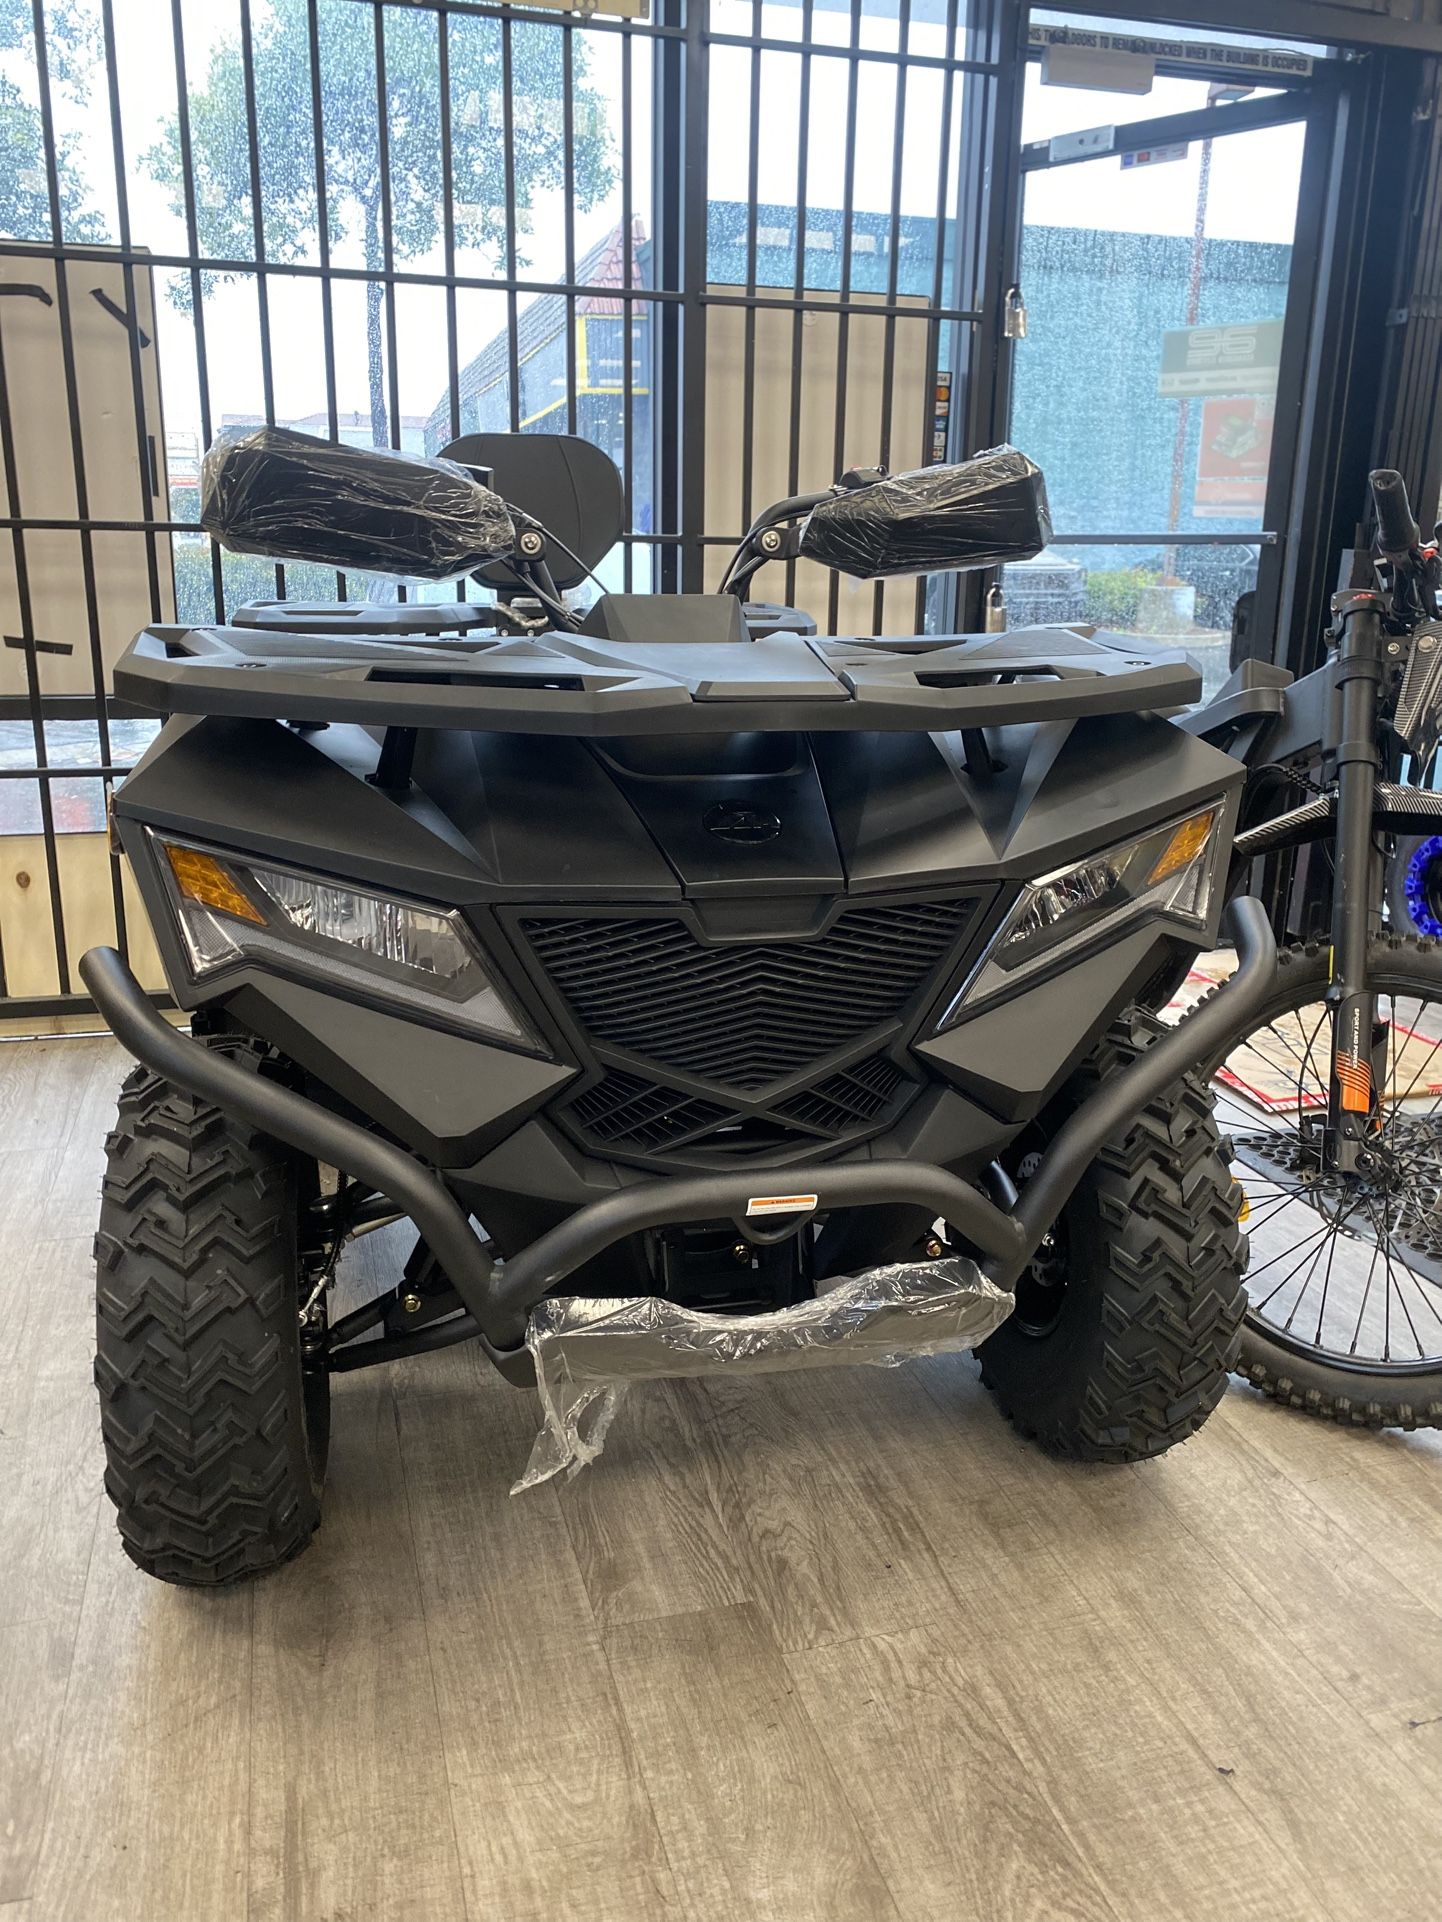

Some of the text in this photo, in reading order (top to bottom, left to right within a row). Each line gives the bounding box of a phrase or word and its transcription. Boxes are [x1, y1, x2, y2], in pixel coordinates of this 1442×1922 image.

[1071, 32, 1097, 48] DOORS
[1100, 35, 1109, 49] TO
[1186, 46, 1207, 59] WHEN
[1210, 48, 1224, 62] THE
[1226, 51, 1260, 66] BUILDING
[1262, 54, 1269, 67] IS
[1271, 56, 1308, 71] OCCUPIED
